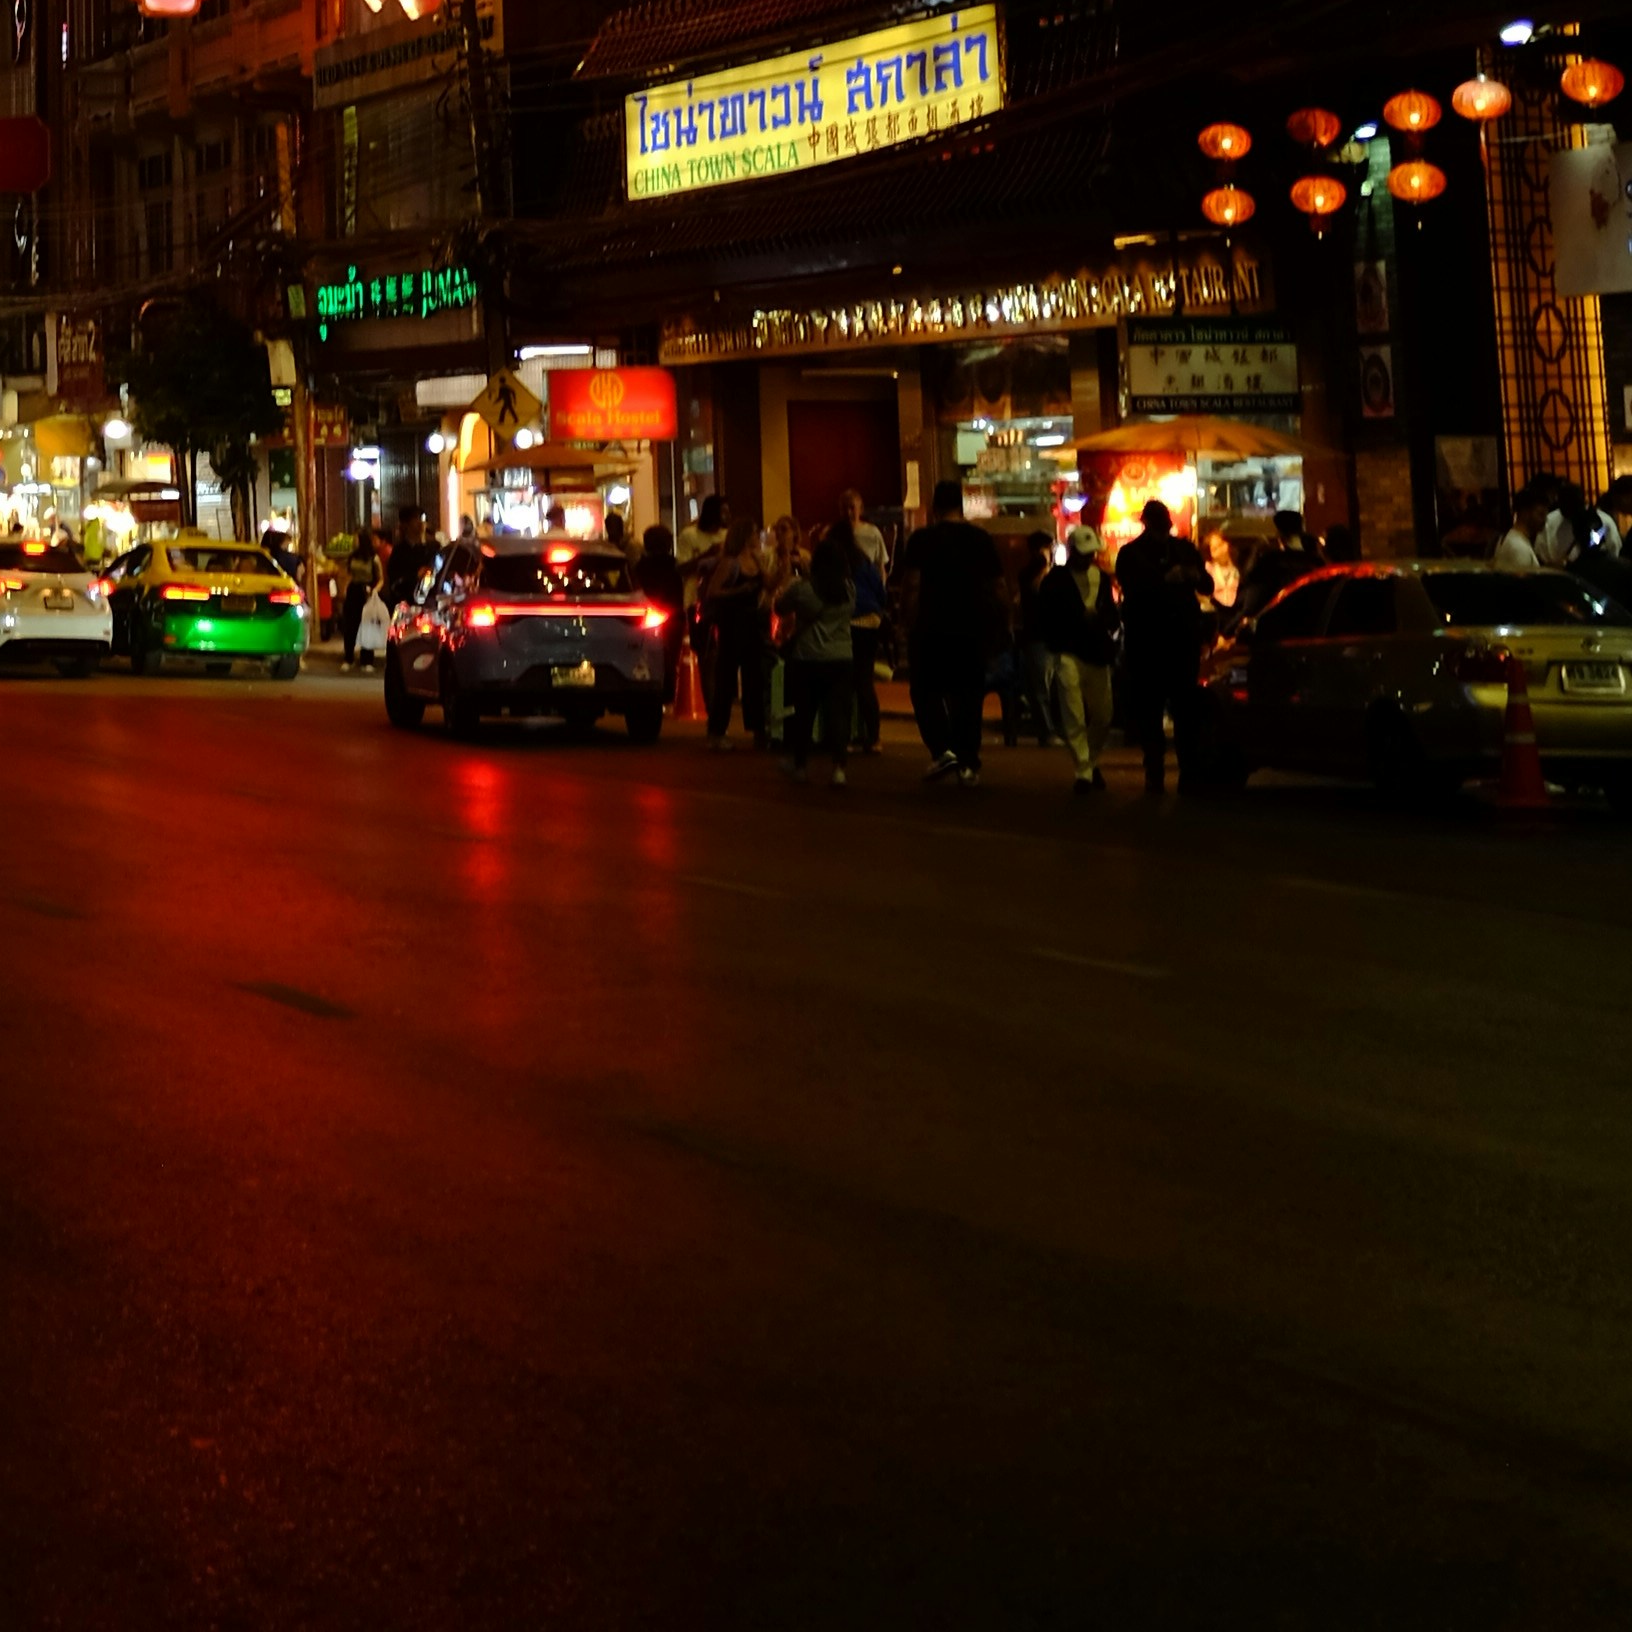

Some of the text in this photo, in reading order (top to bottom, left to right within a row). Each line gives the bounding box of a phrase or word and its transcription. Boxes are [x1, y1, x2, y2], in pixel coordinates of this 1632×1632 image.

[632, 14, 990, 155] ไชน่าทาวน์ สกาล่า
[634, 139, 800, 195] CHINA TOWN SCALA
